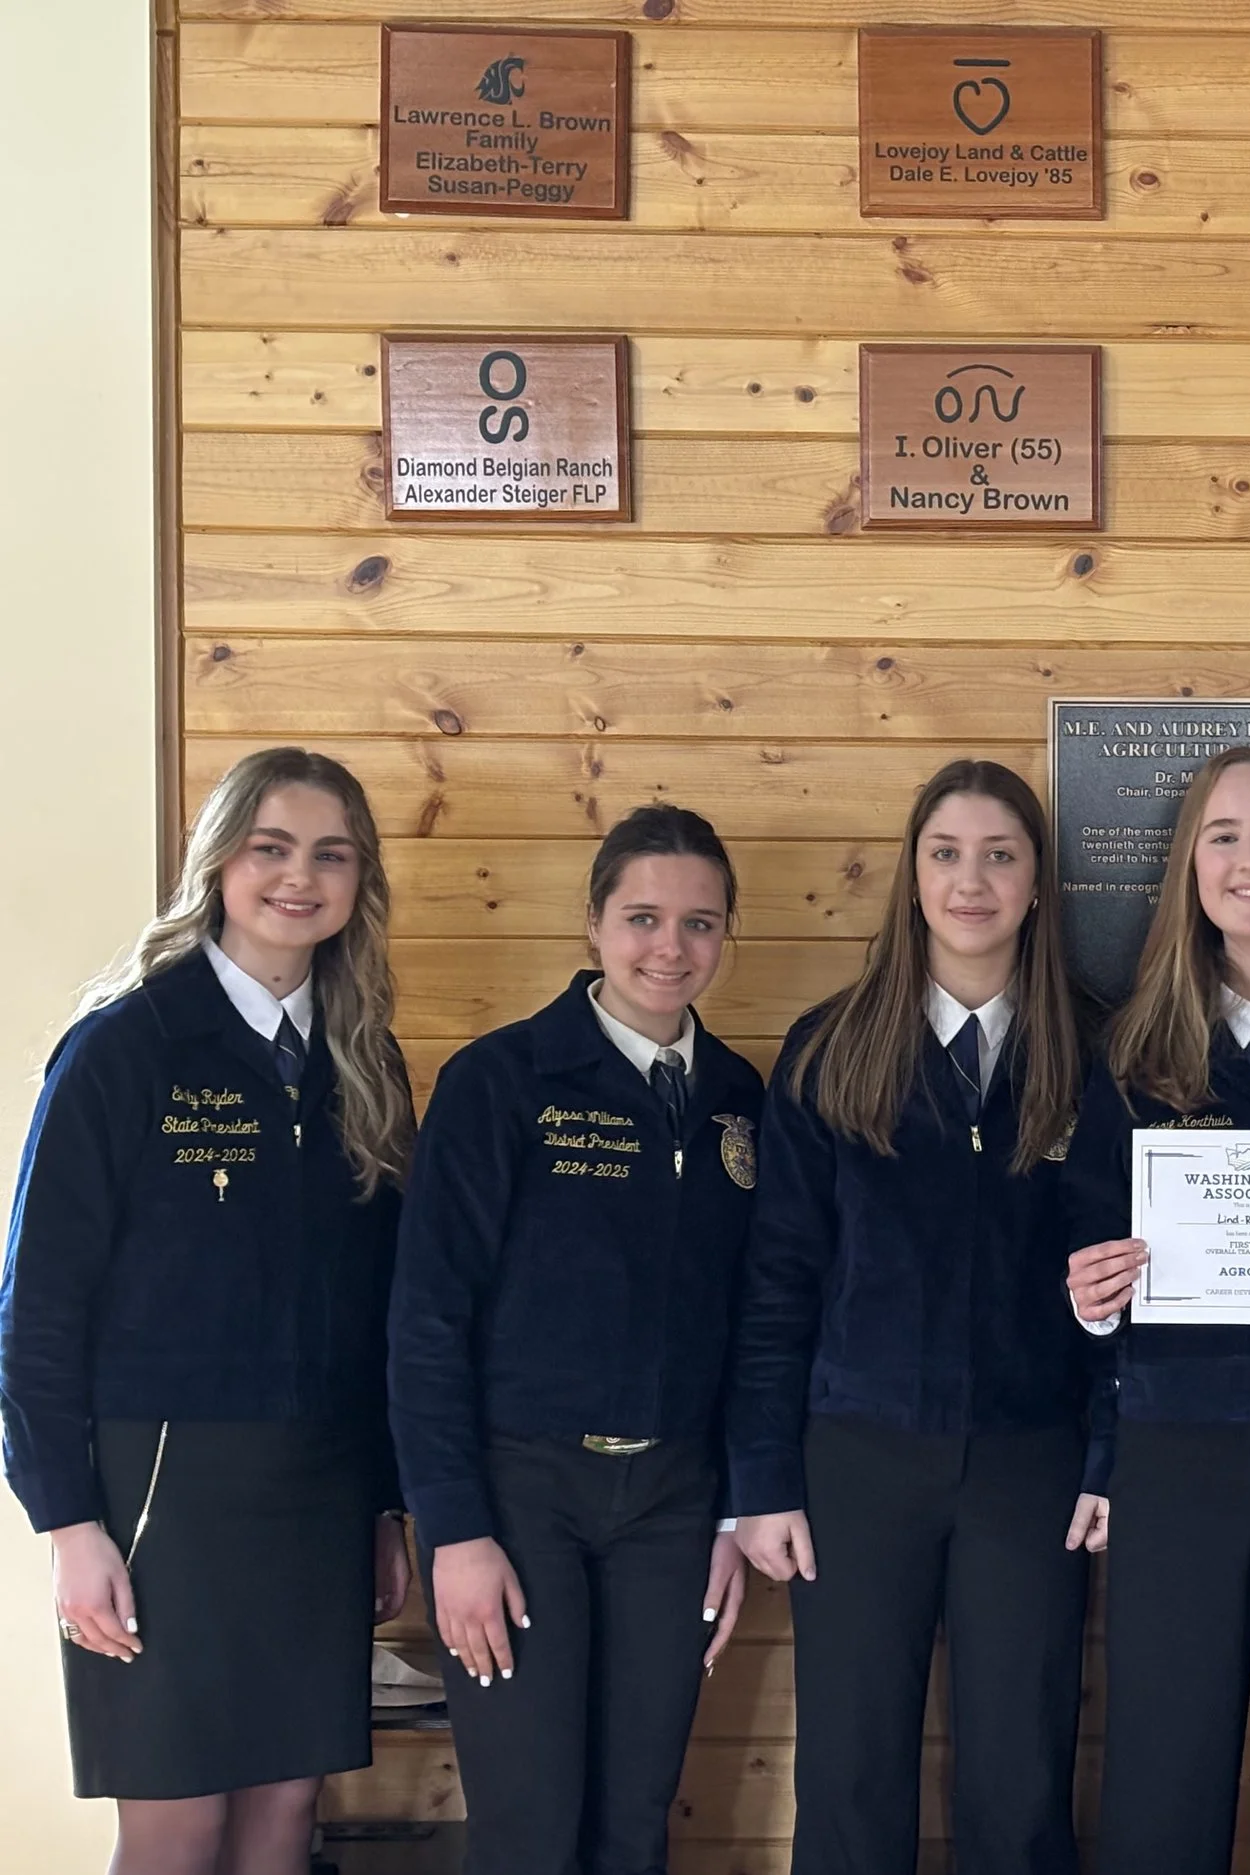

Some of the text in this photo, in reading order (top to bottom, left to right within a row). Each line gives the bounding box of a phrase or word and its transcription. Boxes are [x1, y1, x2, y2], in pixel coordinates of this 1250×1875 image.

[394, 105, 611, 132] Lawrence L. Brown
[466, 130, 538, 154] Family
[875, 142, 1088, 163] Lovejoy Land & Cattle
[416, 151, 587, 181] Elizabeth-Terry
[890, 165, 1073, 187] Dale E. Lovejoy '85
[428, 175, 575, 203] Susan-Peggy
[895, 435, 1062, 465] I. Oliver (55)
[397, 457, 613, 481] Diamond Belgian Ranch
[970, 464, 990, 486] &
[405, 484, 607, 508] Alexander Steiger FLP
[890, 486, 1069, 515] Nancy Brown
[1064, 721, 1106, 737] M.E.
[1111, 721, 1153, 737] AND
[1158, 721, 1241, 737] AUDREY
[1155, 771, 1176, 783] Dr.
[1117, 787, 1152, 798] Chair,
[1082, 826, 1106, 837] One
[1108, 827, 1120, 837] of
[1123, 827, 1141, 837] the
[1144, 827, 1173, 837] most
[1082, 841, 1134, 850] twentieth
[1091, 854, 1123, 863] credit
[1127, 854, 1138, 863] to
[1141, 854, 1158, 864] his
[1063, 882, 1102, 892] Named
[1106, 882, 1116, 892] in
[201, 1088, 244, 1110] Ryder
[161, 1116, 260, 1133] State President
[537, 1105, 634, 1127] Alyssa Williams
[544, 1132, 642, 1153] District President
[174, 1148, 256, 1163] 2024-2025
[552, 1161, 630, 1178] 2024-2025
